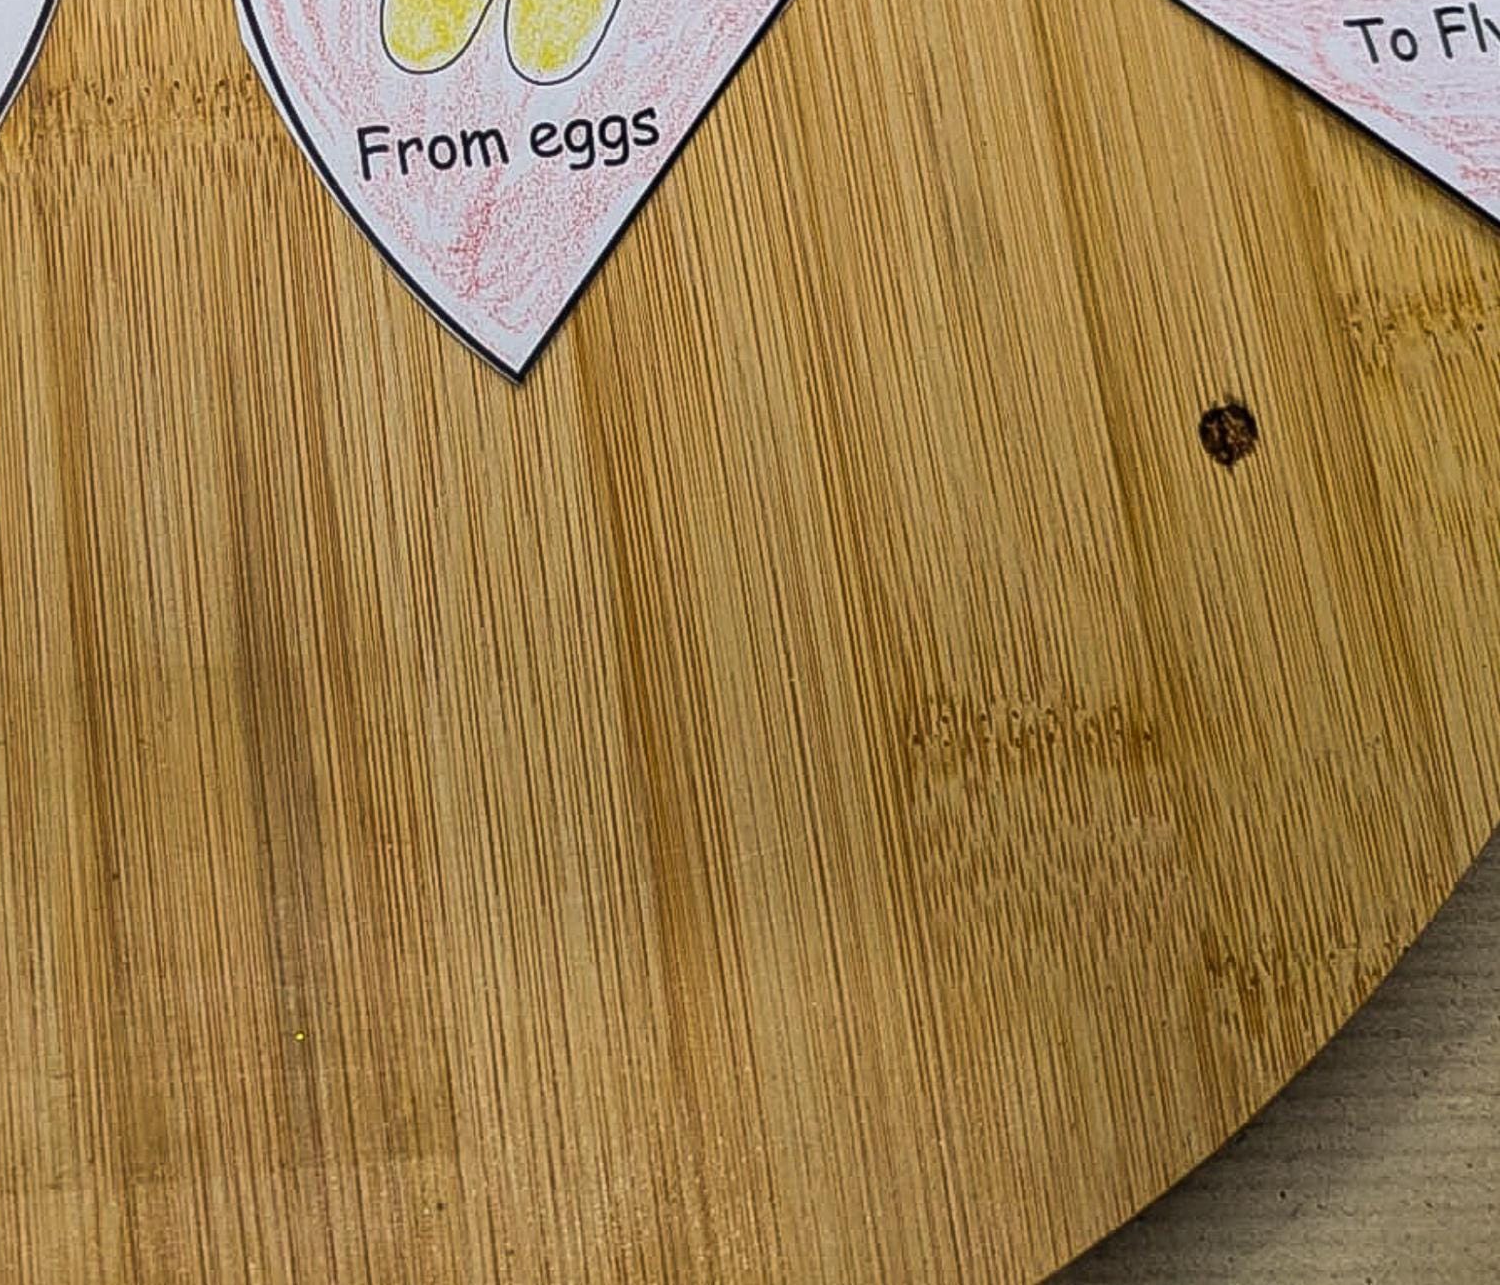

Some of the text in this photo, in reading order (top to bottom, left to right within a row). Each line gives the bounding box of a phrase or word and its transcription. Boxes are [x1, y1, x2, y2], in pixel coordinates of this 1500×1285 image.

[1342, 17, 1418, 64] To
[356, 107, 660, 182] From eggs
